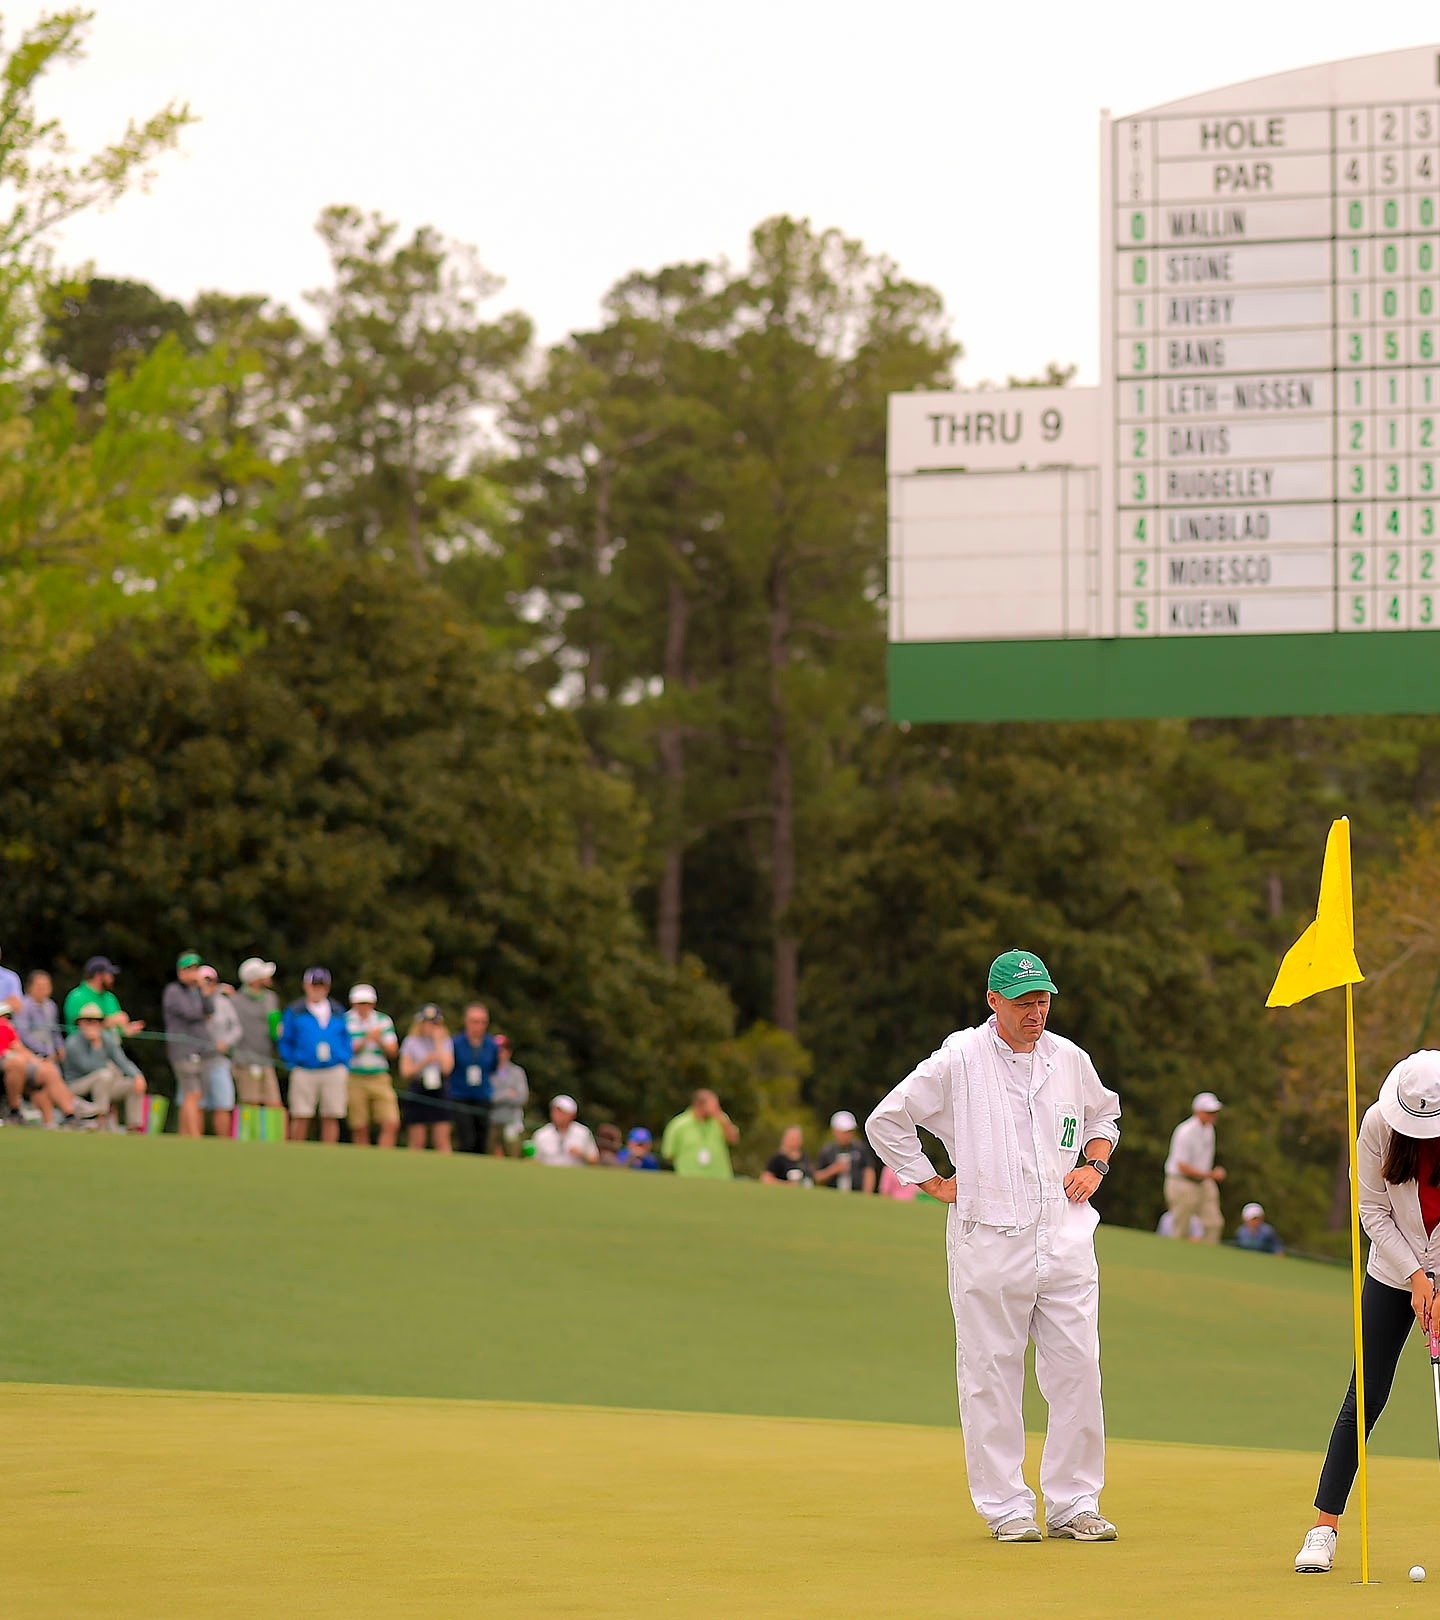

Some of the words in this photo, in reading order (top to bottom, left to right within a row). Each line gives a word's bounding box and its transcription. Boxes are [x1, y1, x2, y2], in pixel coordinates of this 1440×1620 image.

[1200, 117, 1286, 149] HOLE
[1382, 112, 1396, 141] 2
[1417, 110, 1431, 139] 3
[1213, 161, 1273, 192] PAR
[1348, 158, 1362, 187] 4
[1383, 156, 1397, 185] 5
[1416, 154, 1430, 183] 4
[1132, 212, 1145, 241] 0
[1350, 202, 1362, 230] 0
[1384, 200, 1398, 228] 0
[1420, 198, 1434, 226] 0
[1134, 256, 1147, 285] 0
[1166, 251, 1234, 284] STONE
[1384, 244, 1398, 274] 0
[1420, 244, 1432, 272] 0
[1166, 296, 1235, 326] AVERY
[1384, 288, 1396, 318] 0
[1420, 286, 1432, 316] 0
[1134, 341, 1147, 372] 3
[1167, 339, 1225, 369] BANG
[1350, 334, 1362, 362] 3
[1386, 332, 1398, 360] 5
[1420, 330, 1434, 360] 6
[1167, 378, 1314, 414] LETH-NISSEN
[927, 410, 1023, 446] THRU
[1040, 407, 1063, 442] 9
[1133, 429, 1146, 459] 2
[1167, 424, 1230, 456] DAVIS
[1352, 422, 1364, 450] 2
[1133, 472, 1146, 501] 3
[1166, 467, 1274, 498] RUDGELEY
[1352, 466, 1364, 494] 3
[1388, 464, 1398, 492] 3
[1422, 462, 1434, 492] 3
[1134, 516, 1147, 543] 4
[1168, 511, 1271, 543] LINDBLAD
[1352, 509, 1366, 538] 4
[1386, 508, 1400, 536] 4
[1422, 508, 1434, 536] 3
[1135, 558, 1147, 587] 2
[1168, 555, 1272, 585] MORESCO
[1350, 552, 1366, 582] 2
[1388, 552, 1400, 580] 2
[1420, 550, 1434, 580] 2
[1135, 601, 1148, 630] 5
[1168, 599, 1240, 627] KUEHN
[1352, 596, 1366, 625] 5
[1386, 595, 1400, 624] 4
[1421, 594, 1435, 623] 3
[1061, 1116, 1077, 1148] 26
